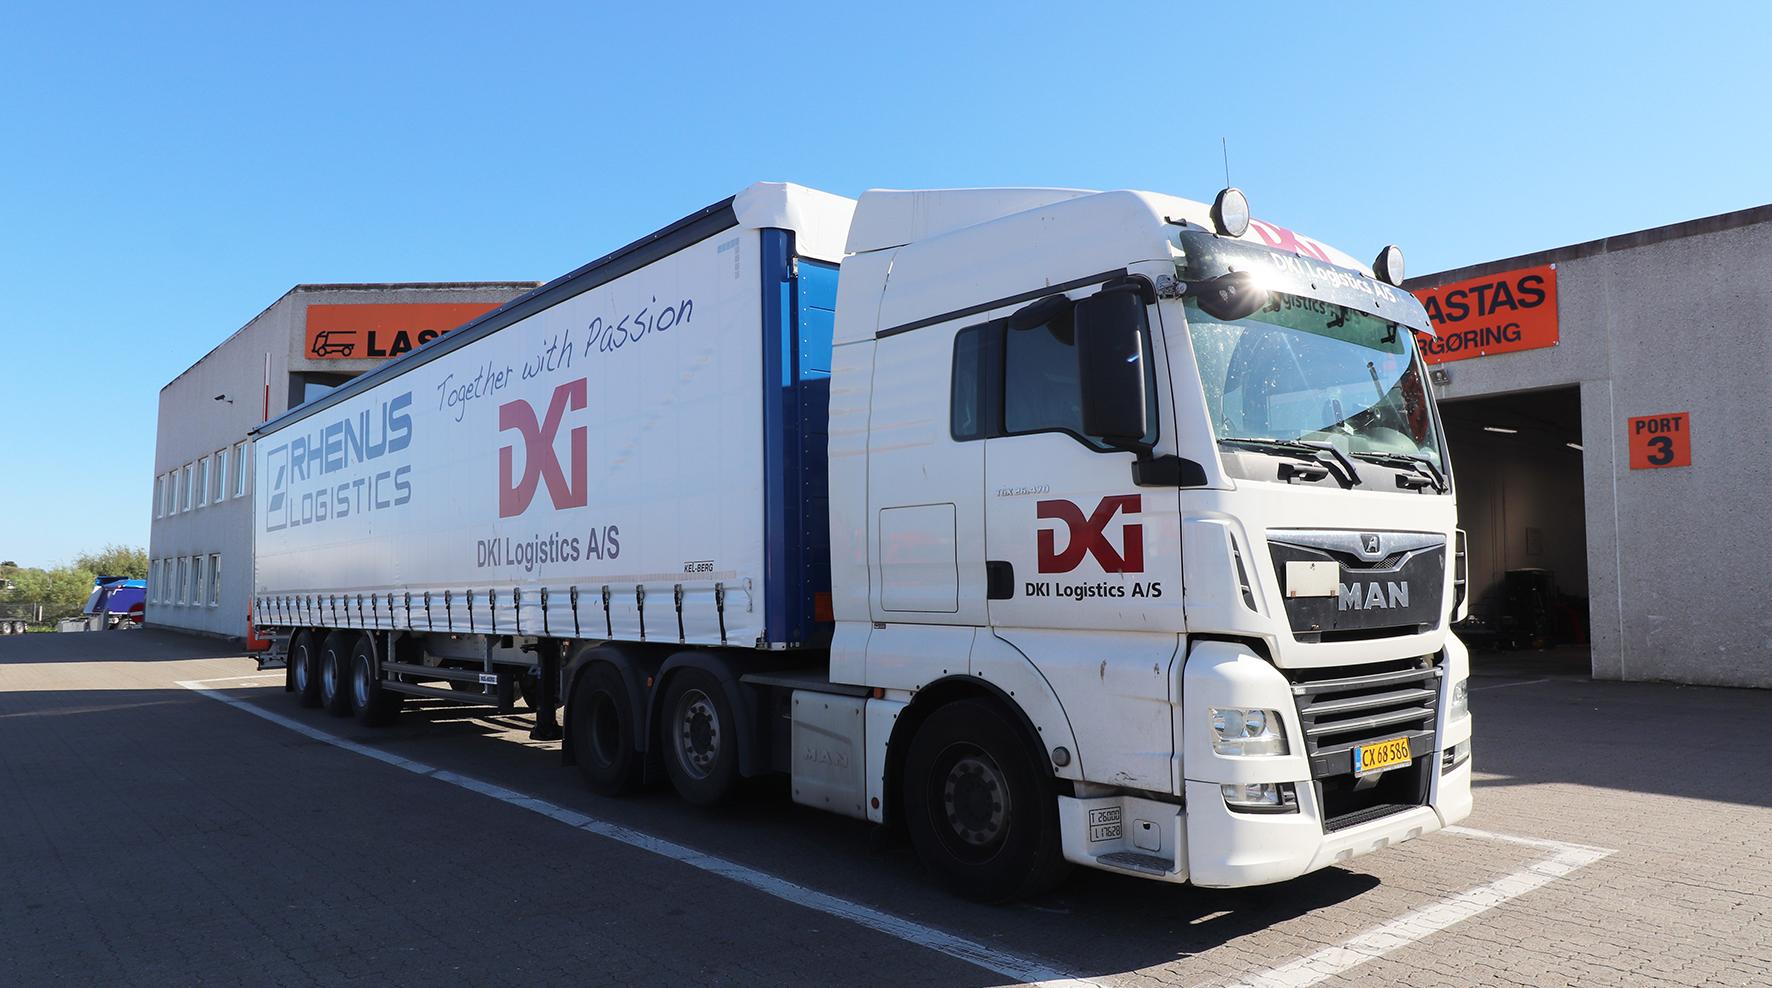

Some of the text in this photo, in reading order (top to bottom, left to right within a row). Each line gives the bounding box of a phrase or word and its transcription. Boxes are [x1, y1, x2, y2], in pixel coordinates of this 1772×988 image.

[1305, 260, 1372, 294] Logistics
[367, 329, 451, 357] LAS
[438, 295, 694, 423] Together with Passion
[290, 391, 413, 485] RHENUS
[1635, 416, 1683, 435] PORT
[1647, 436, 1675, 466] 3
[289, 464, 412, 528] LOGISTICS
[477, 525, 621, 574] DKI Logistics A/S
[683, 563, 714, 573] KEL-BERG
[1025, 581, 1162, 601] DKI Logistics A/S
[1338, 581, 1410, 611] MAN
[1362, 741, 1409, 767] CX 68 586
[1098, 810, 1120, 823] 26000
